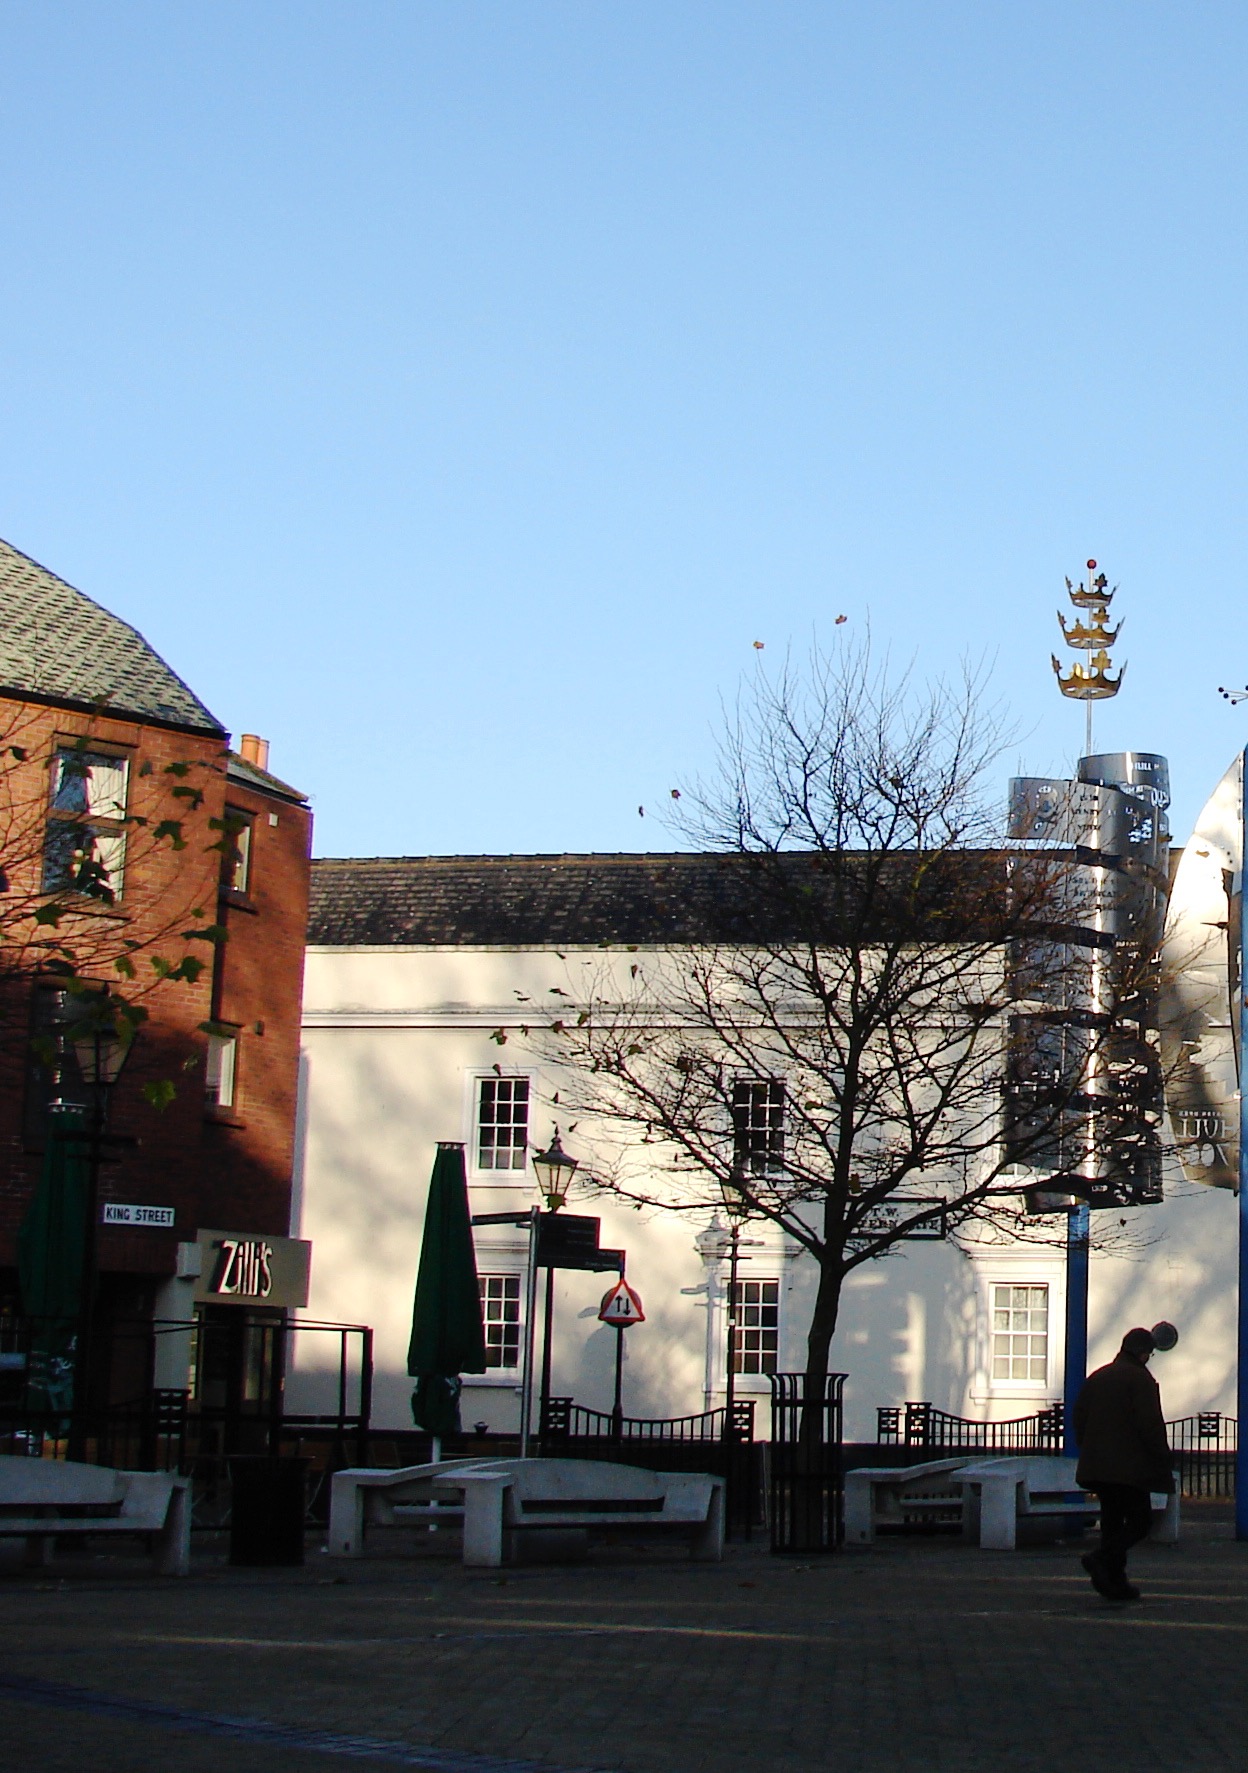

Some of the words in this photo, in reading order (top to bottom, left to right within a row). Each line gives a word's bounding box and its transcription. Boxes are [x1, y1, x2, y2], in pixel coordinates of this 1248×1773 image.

[105, 1206, 130, 1220] KING
[135, 1208, 173, 1223] STREET
[218, 1240, 273, 1298] Zilli's
